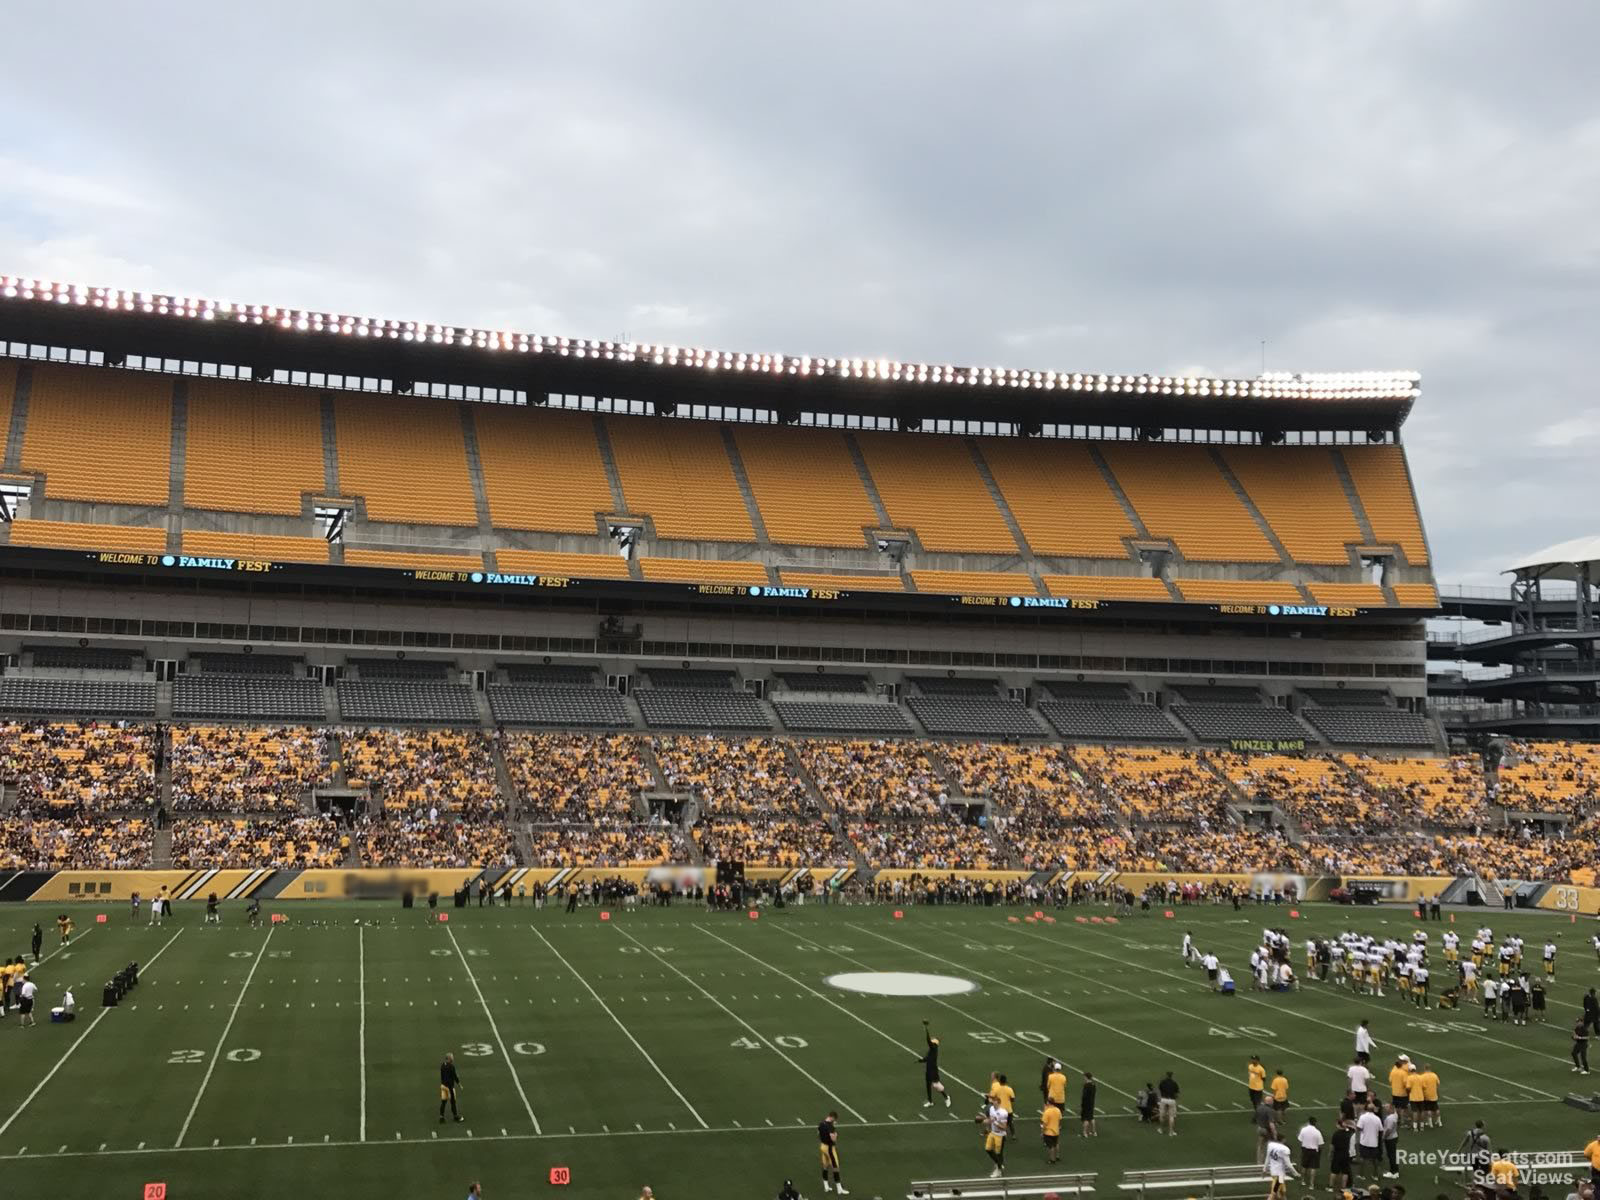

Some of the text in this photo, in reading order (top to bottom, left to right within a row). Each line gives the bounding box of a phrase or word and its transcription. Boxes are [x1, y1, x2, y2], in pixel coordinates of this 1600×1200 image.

[99, 552, 272, 573] WELCOME TO FAMILY FEST
[414, 570, 570, 588] WELCOME TO FAMILY FEST
[698, 584, 840, 600] WELCOME TO FAMILY FEST
[961, 596, 1100, 610] WELCOME TO FAMILY FEST
[1220, 604, 1358, 617] WELCOME TO FAMILY FEST
[1231, 739, 1275, 751] YINZER
[1556, 887, 1578, 910] 33
[967, 1030, 1051, 1044] 50
[1208, 1026, 1278, 1039] 40
[460, 1042, 547, 1057] 30
[729, 1035, 809, 1050] 40
[167, 1048, 262, 1063] 20
[554, 1169, 568, 1182] 30
[147, 1186, 163, 1198] 20
